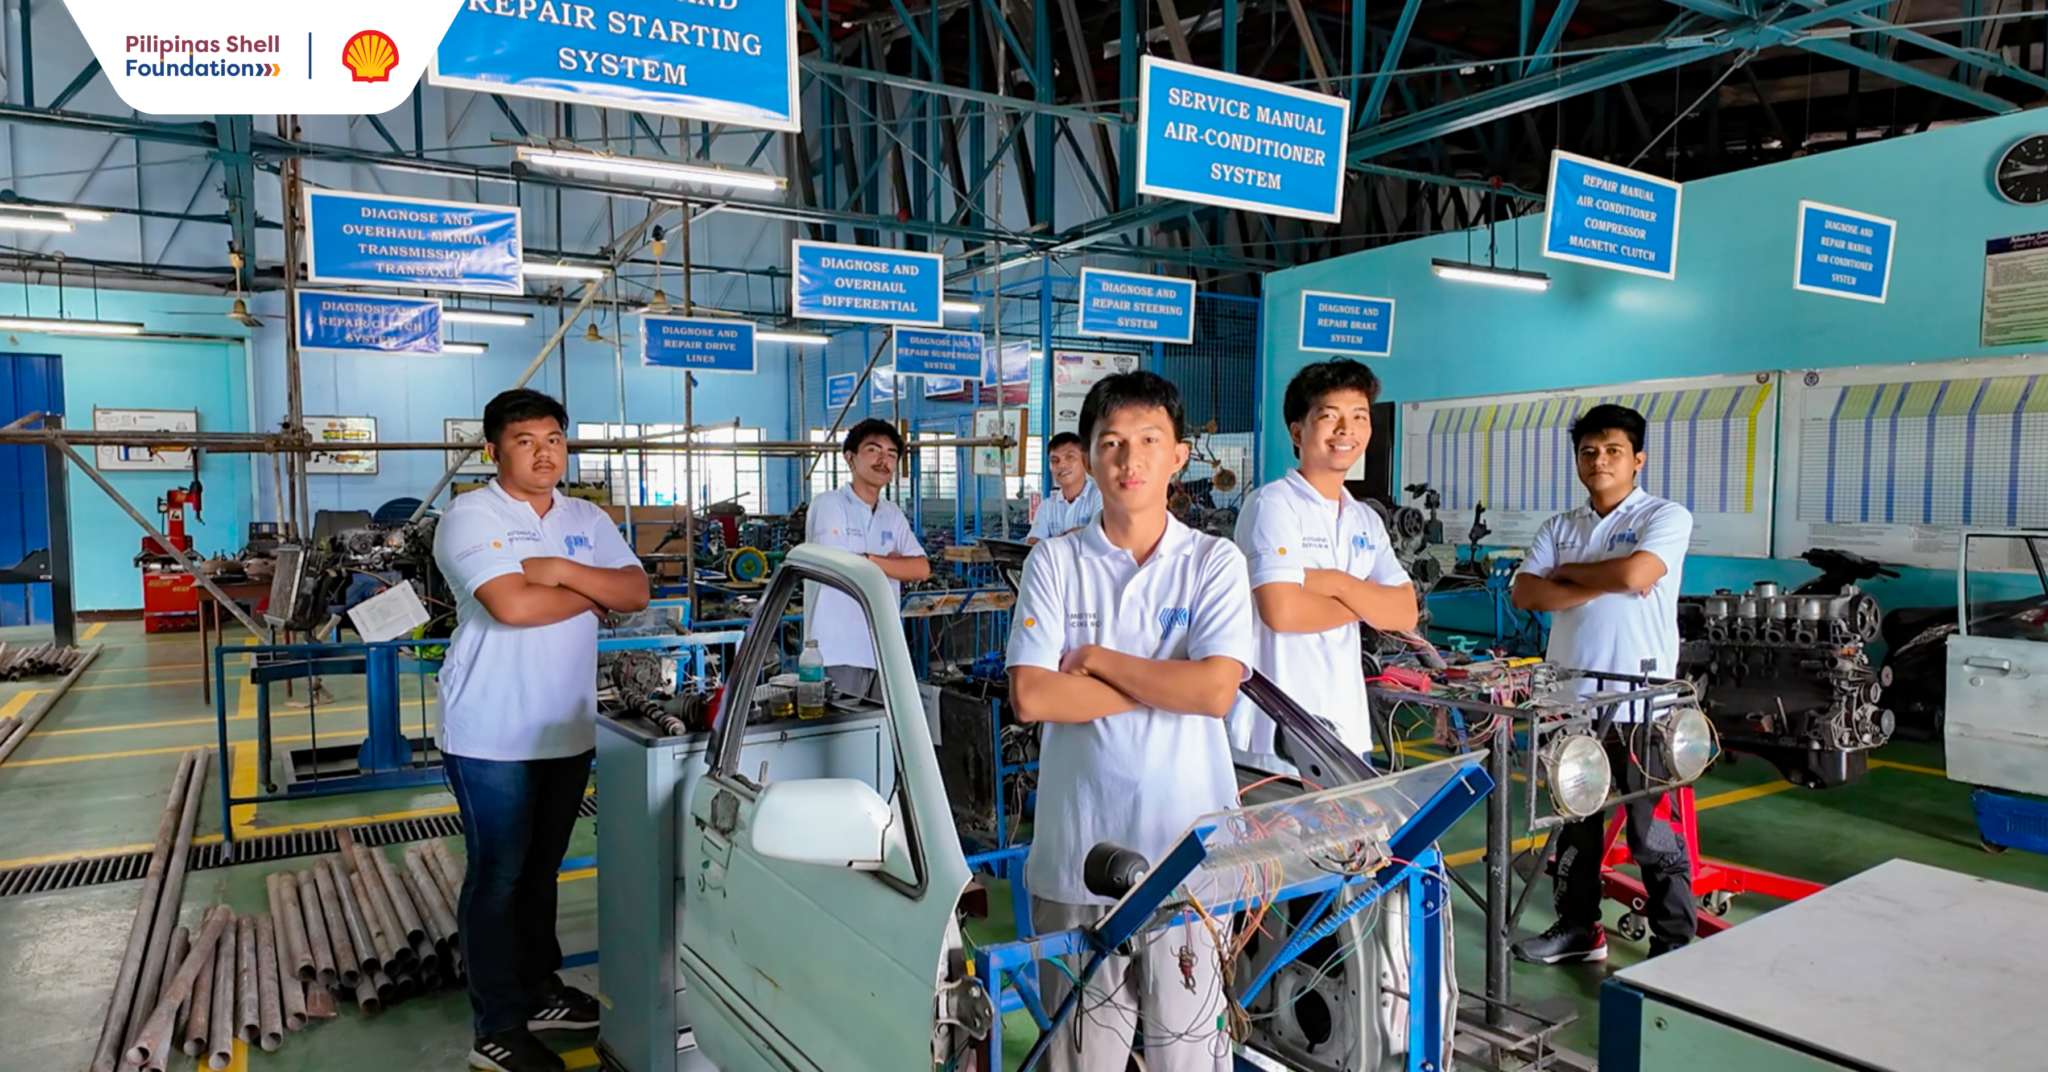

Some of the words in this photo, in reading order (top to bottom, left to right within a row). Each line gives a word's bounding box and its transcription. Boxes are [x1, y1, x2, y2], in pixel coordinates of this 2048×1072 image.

[608, 10, 762, 56] STARTING
[558, 47, 687, 86] SYSTEM
[1168, 87, 1250, 120] SERVICE
[1256, 105, 1326, 135] MANUAL
[1164, 121, 1326, 167] AIR-CONDITIONER
[1210, 162, 1282, 190] SYSTEM
[1583, 174, 1618, 193] REPAIR
[1620, 184, 1655, 202] MANUAL
[361, 206, 438, 224] DIAGNOSE
[443, 213, 473, 226] AND
[342, 223, 426, 241] OVERHAUL
[431, 230, 490, 246] MANUAL
[1584, 217, 1647, 240] COMPRESSOR
[1824, 219, 1858, 235] DIAGNOSE
[1860, 227, 1874, 238] AND
[1569, 235, 1618, 254] MAGNETIC
[1620, 245, 1656, 262] CLUTCH
[1821, 236, 1846, 249] REPAIR
[1847, 241, 1873, 255] MANUAL
[375, 262, 463, 279] TRANSAXLE
[821, 257, 889, 274] DIAGNOSE
[893, 264, 920, 276] AND
[835, 277, 906, 294] OVERHAUL
[1831, 273, 1857, 286] SYSTEM
[1102, 282, 1154, 297] DIAGNOSE
[1156, 289, 1177, 299] AND
[322, 301, 389, 315] DIAGNOSE
[822, 295, 918, 313] DIFFERENTIAL
[1092, 298, 1131, 311] REPAIR
[1133, 302, 1183, 316] STEERING
[1318, 303, 1361, 315] DIAGNOSE
[1363, 307, 1379, 317] AND
[318, 316, 369, 328] REPAIR
[1117, 317, 1158, 330] SYSTEM
[1317, 318, 1348, 329] REPAIR
[1350, 321, 1378, 331] BRAKE
[662, 326, 714, 337] DIAGNOSE
[717, 330, 738, 338] AND
[1330, 334, 1363, 344] SYSTEM
[664, 339, 702, 349] REPAIR
[705, 342, 736, 351] DRIVE
[909, 336, 952, 347] DIAGNOSE
[686, 354, 715, 363] LINES
[898, 347, 929, 357] REPAIR
[931, 350, 980, 361] SUSPENSION
[923, 361, 956, 371] SYSTEM
